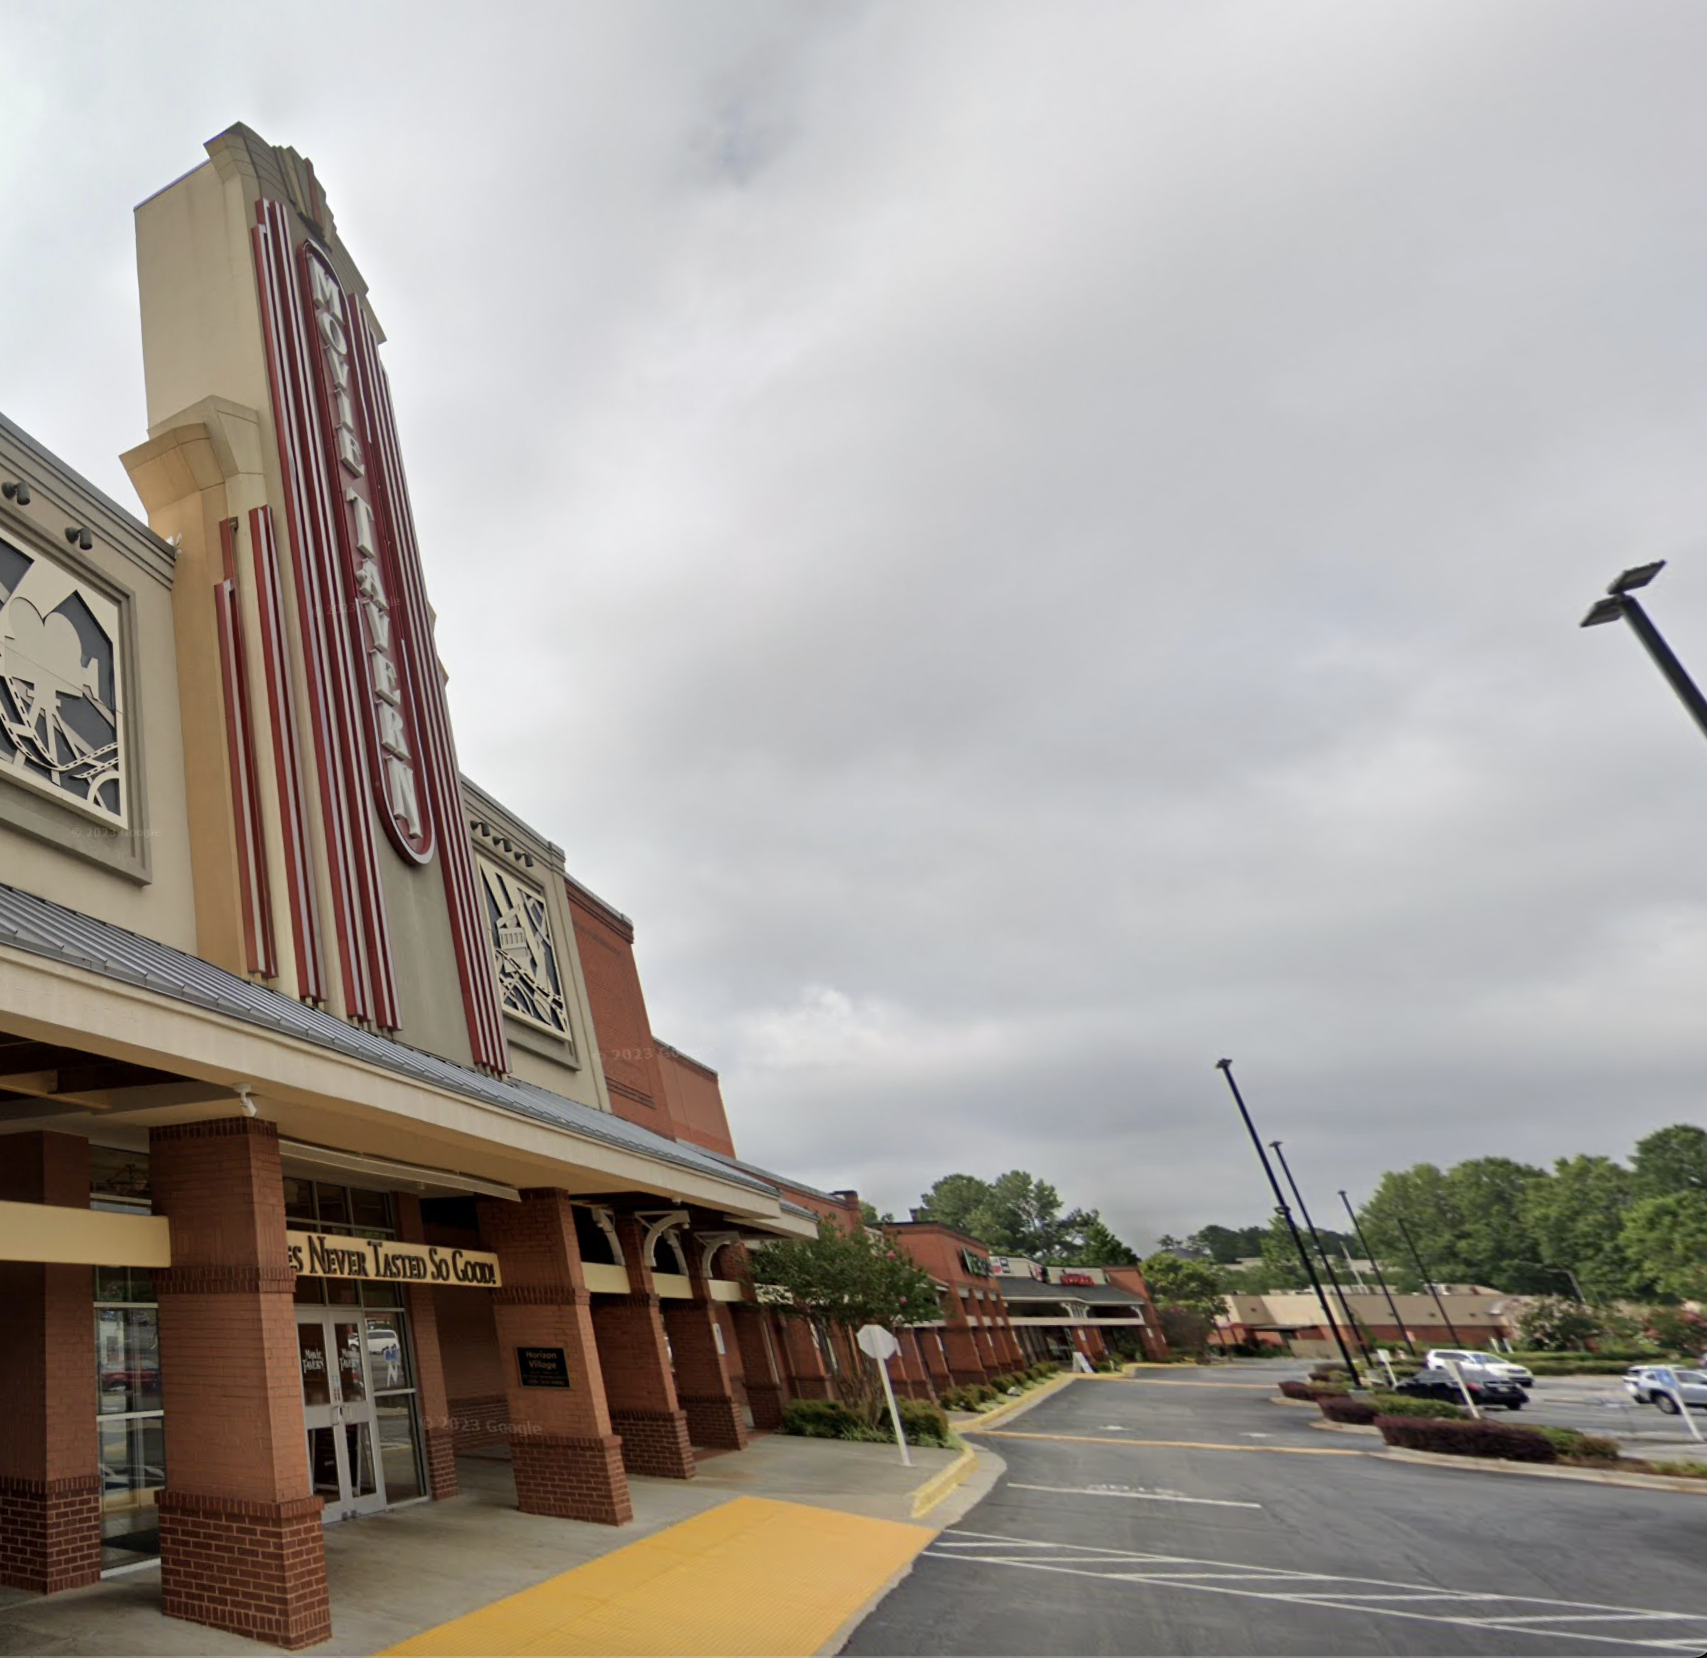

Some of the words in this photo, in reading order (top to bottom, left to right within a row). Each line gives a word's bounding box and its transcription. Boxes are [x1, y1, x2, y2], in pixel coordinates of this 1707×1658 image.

[306, 253, 365, 479] MOVIE
[346, 487, 423, 839] TAVERN
[525, 1350, 557, 1359] Horizon
[528, 1359, 557, 1370] Village
